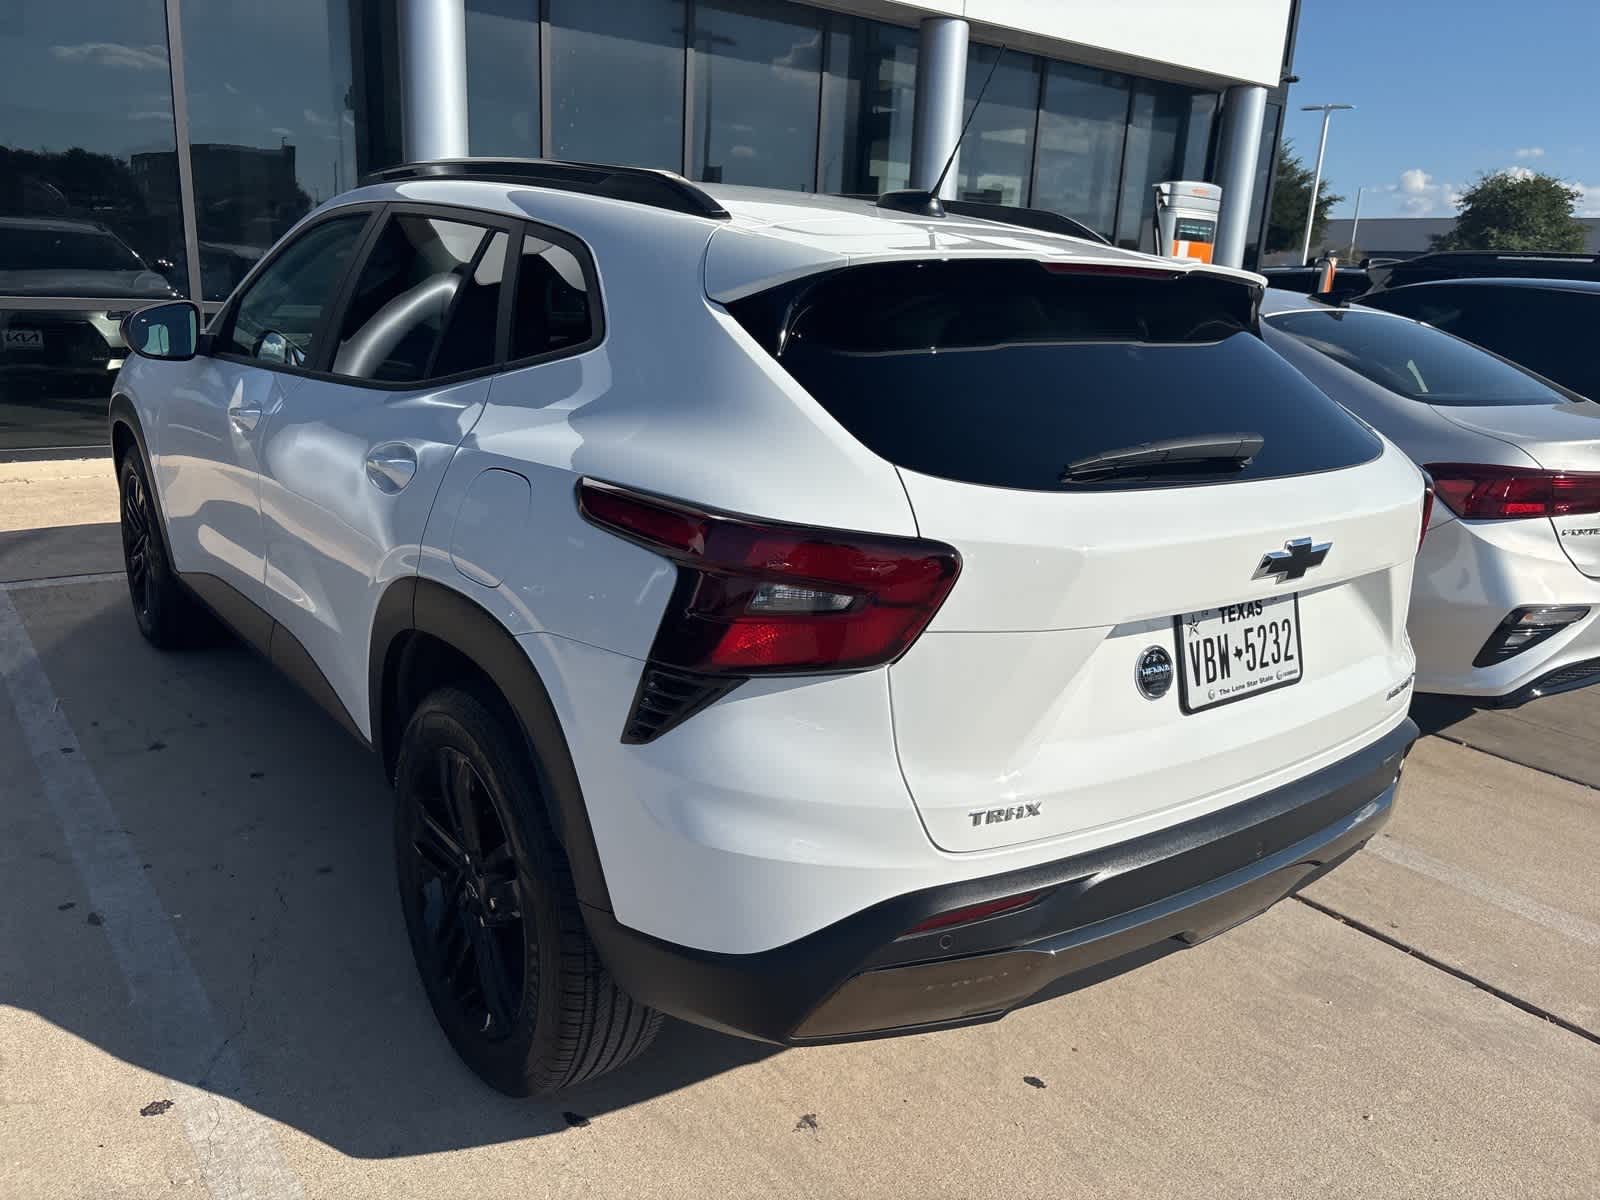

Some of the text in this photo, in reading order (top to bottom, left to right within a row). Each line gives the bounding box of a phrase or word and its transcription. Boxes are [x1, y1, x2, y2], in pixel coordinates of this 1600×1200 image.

[1218, 600, 1263, 624] TEXAS
[1189, 618, 1294, 687] VBW 5232
[1219, 675, 1274, 695] The Lone Star State
[968, 801, 1041, 826] TRAX
